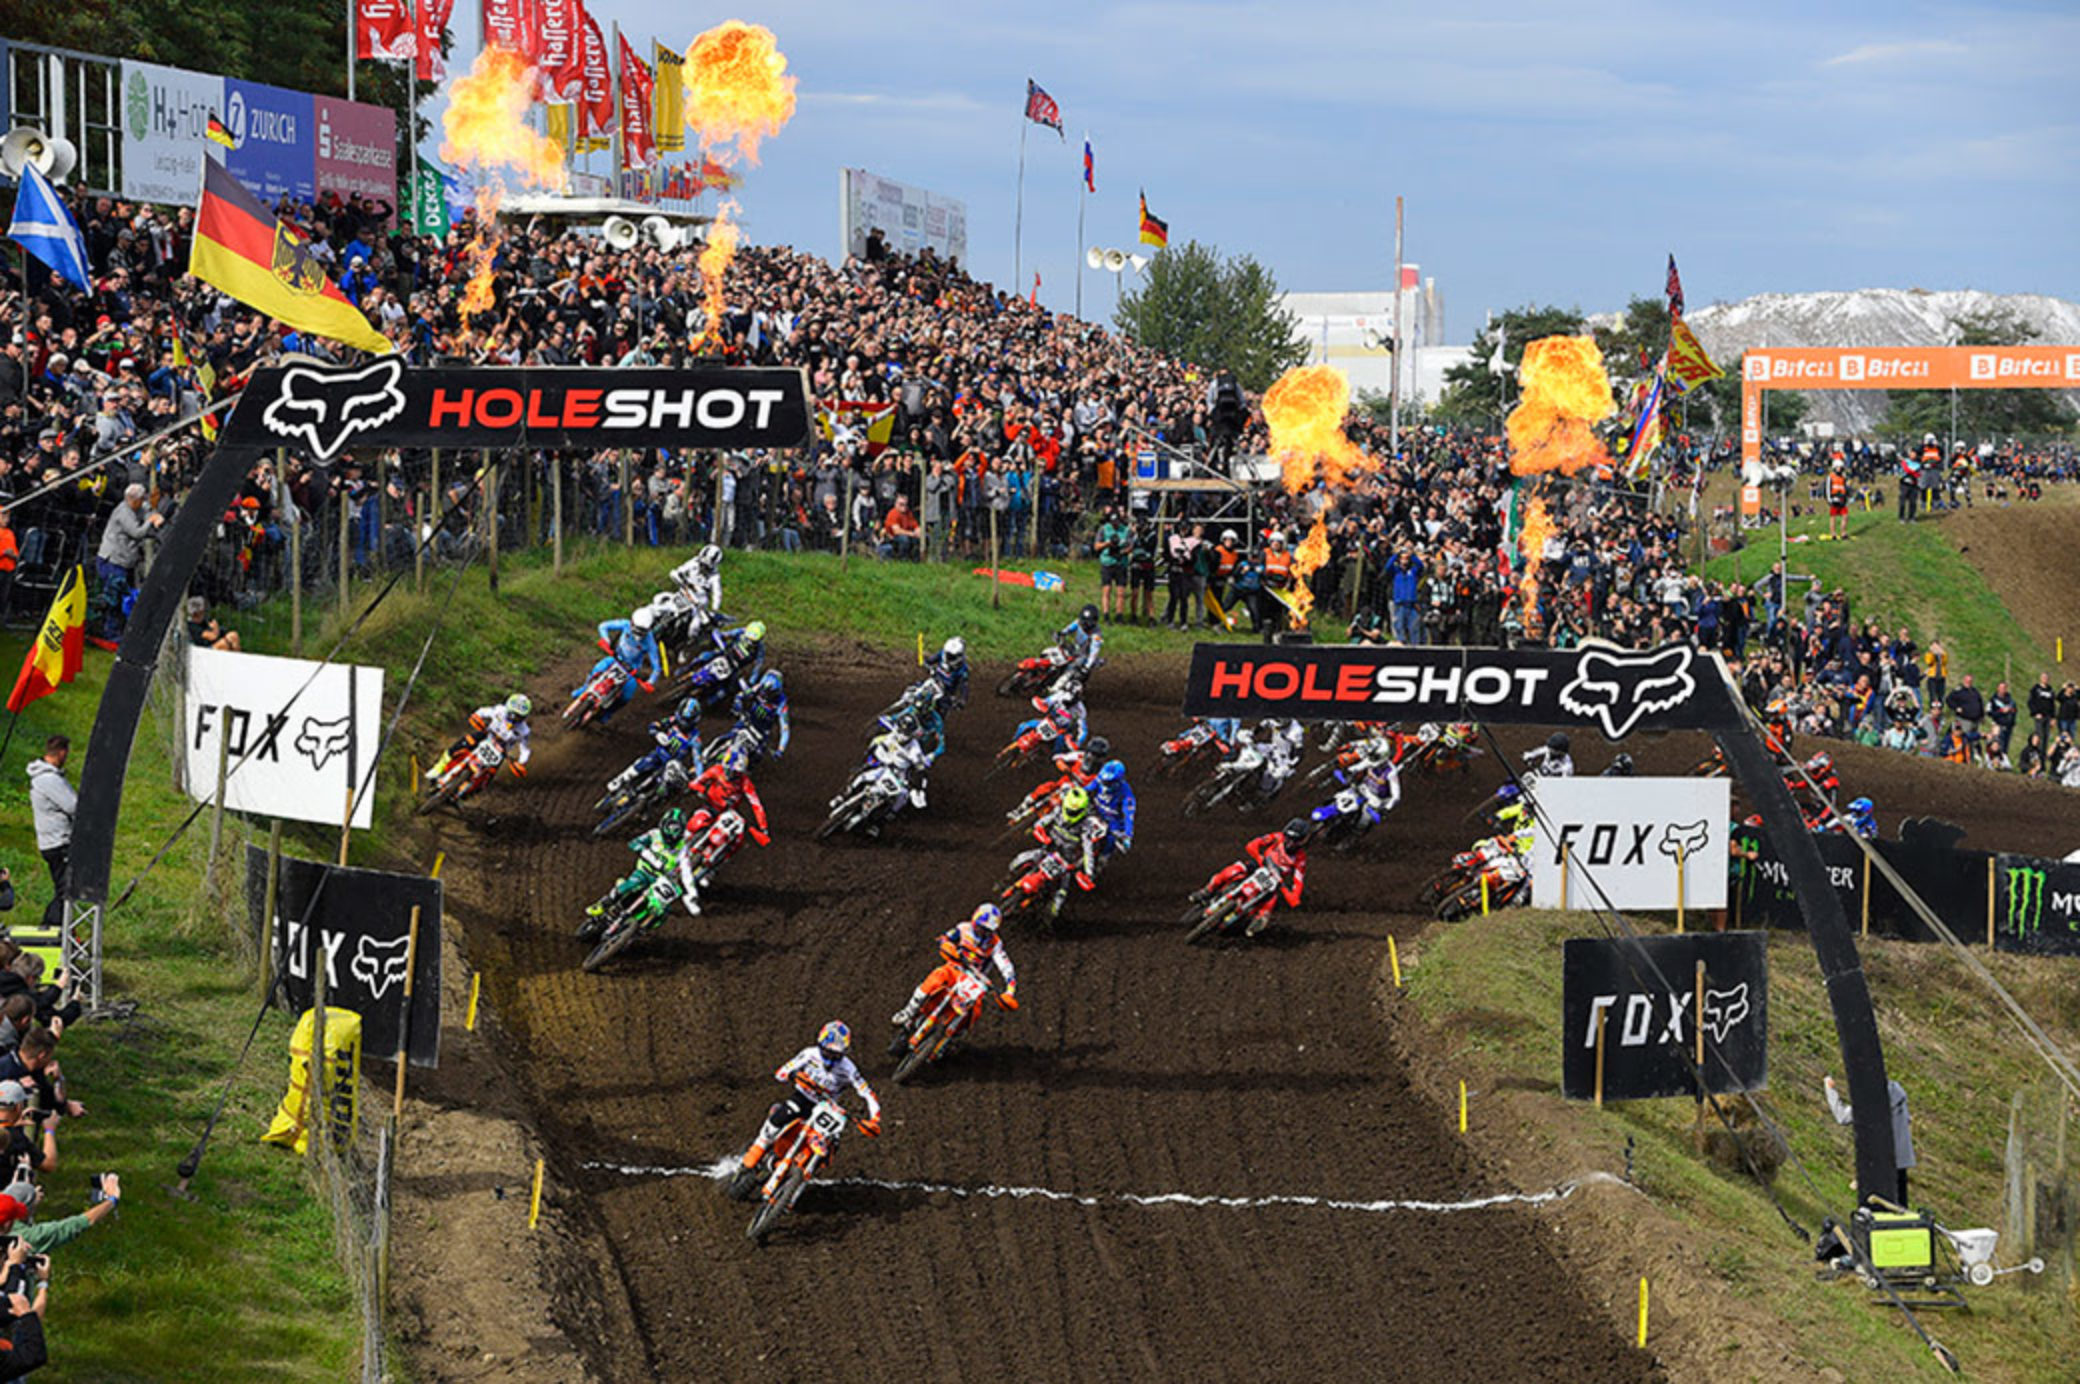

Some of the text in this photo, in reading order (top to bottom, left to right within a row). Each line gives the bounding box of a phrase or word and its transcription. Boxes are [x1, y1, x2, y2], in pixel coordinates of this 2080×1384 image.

[250, 108, 297, 145] ZURICH
[424, 170, 441, 227] DEKRA
[428, 387, 784, 429] HOLESHOT
[1208, 660, 1549, 706] HOLESHOT
[194, 703, 289, 763] FOX
[1553, 823, 1655, 866] FOX
[271, 915, 346, 989] OX
[1583, 991, 1693, 1049] FOX
[815, 1110, 840, 1133] 61
